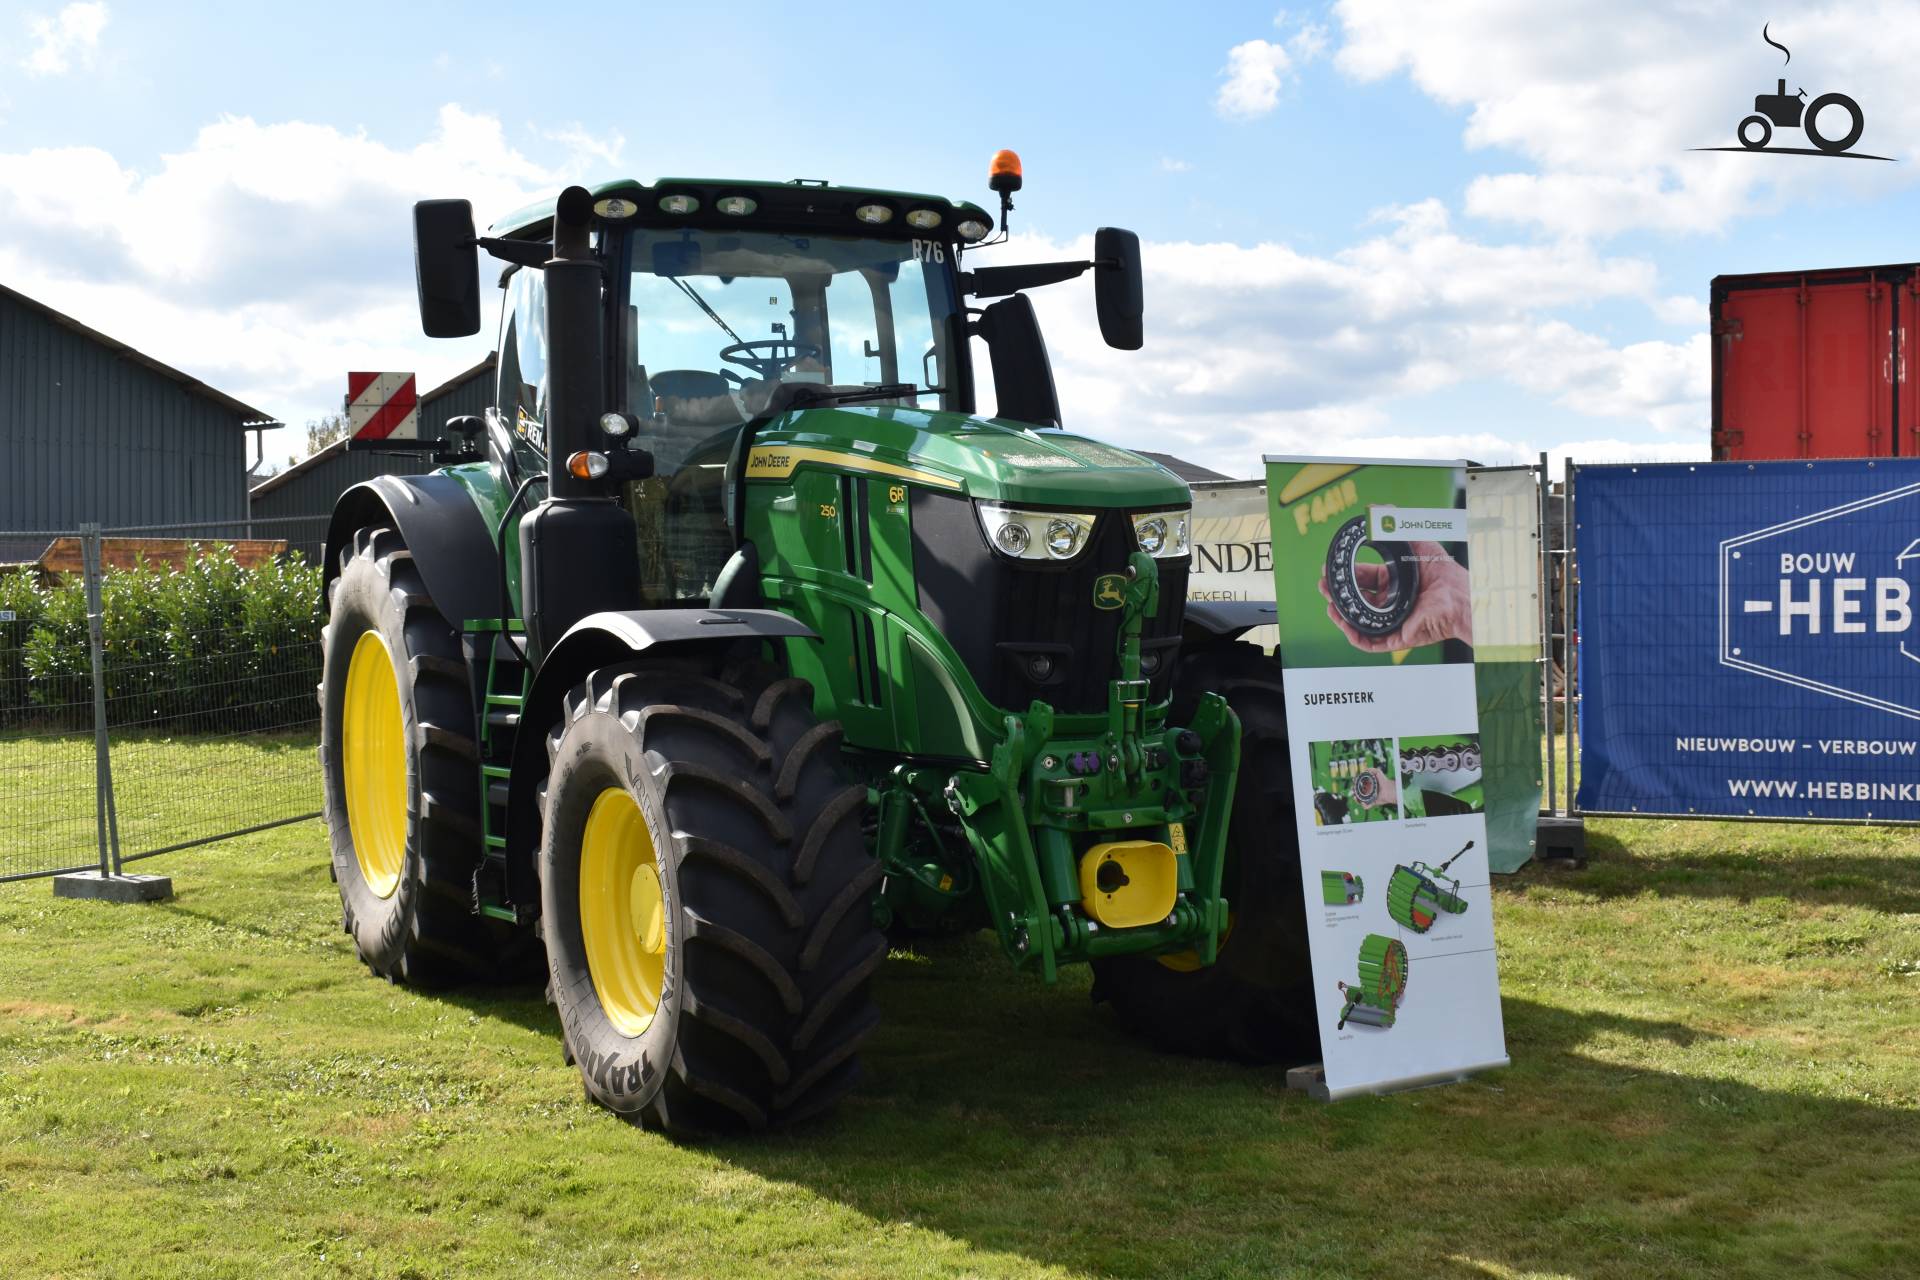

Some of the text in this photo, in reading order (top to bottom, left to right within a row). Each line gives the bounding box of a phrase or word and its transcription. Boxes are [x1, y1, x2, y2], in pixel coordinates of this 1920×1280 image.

[912, 238, 945, 264] R76
[751, 453, 790, 468] JOHN DEERE
[889, 486, 904, 504] 6R
[820, 504, 836, 518] 250
[1399, 519, 1453, 530] JOHN DEERE
[1189, 541, 1274, 574] NDE
[1780, 552, 1856, 574] BOUW
[1303, 691, 1375, 706] SUPERSTERK
[1676, 737, 1796, 753] NIEUWBOUW
[1818, 739, 1917, 755] VERBOUW
[565, 1006, 656, 1097] TRAXION
